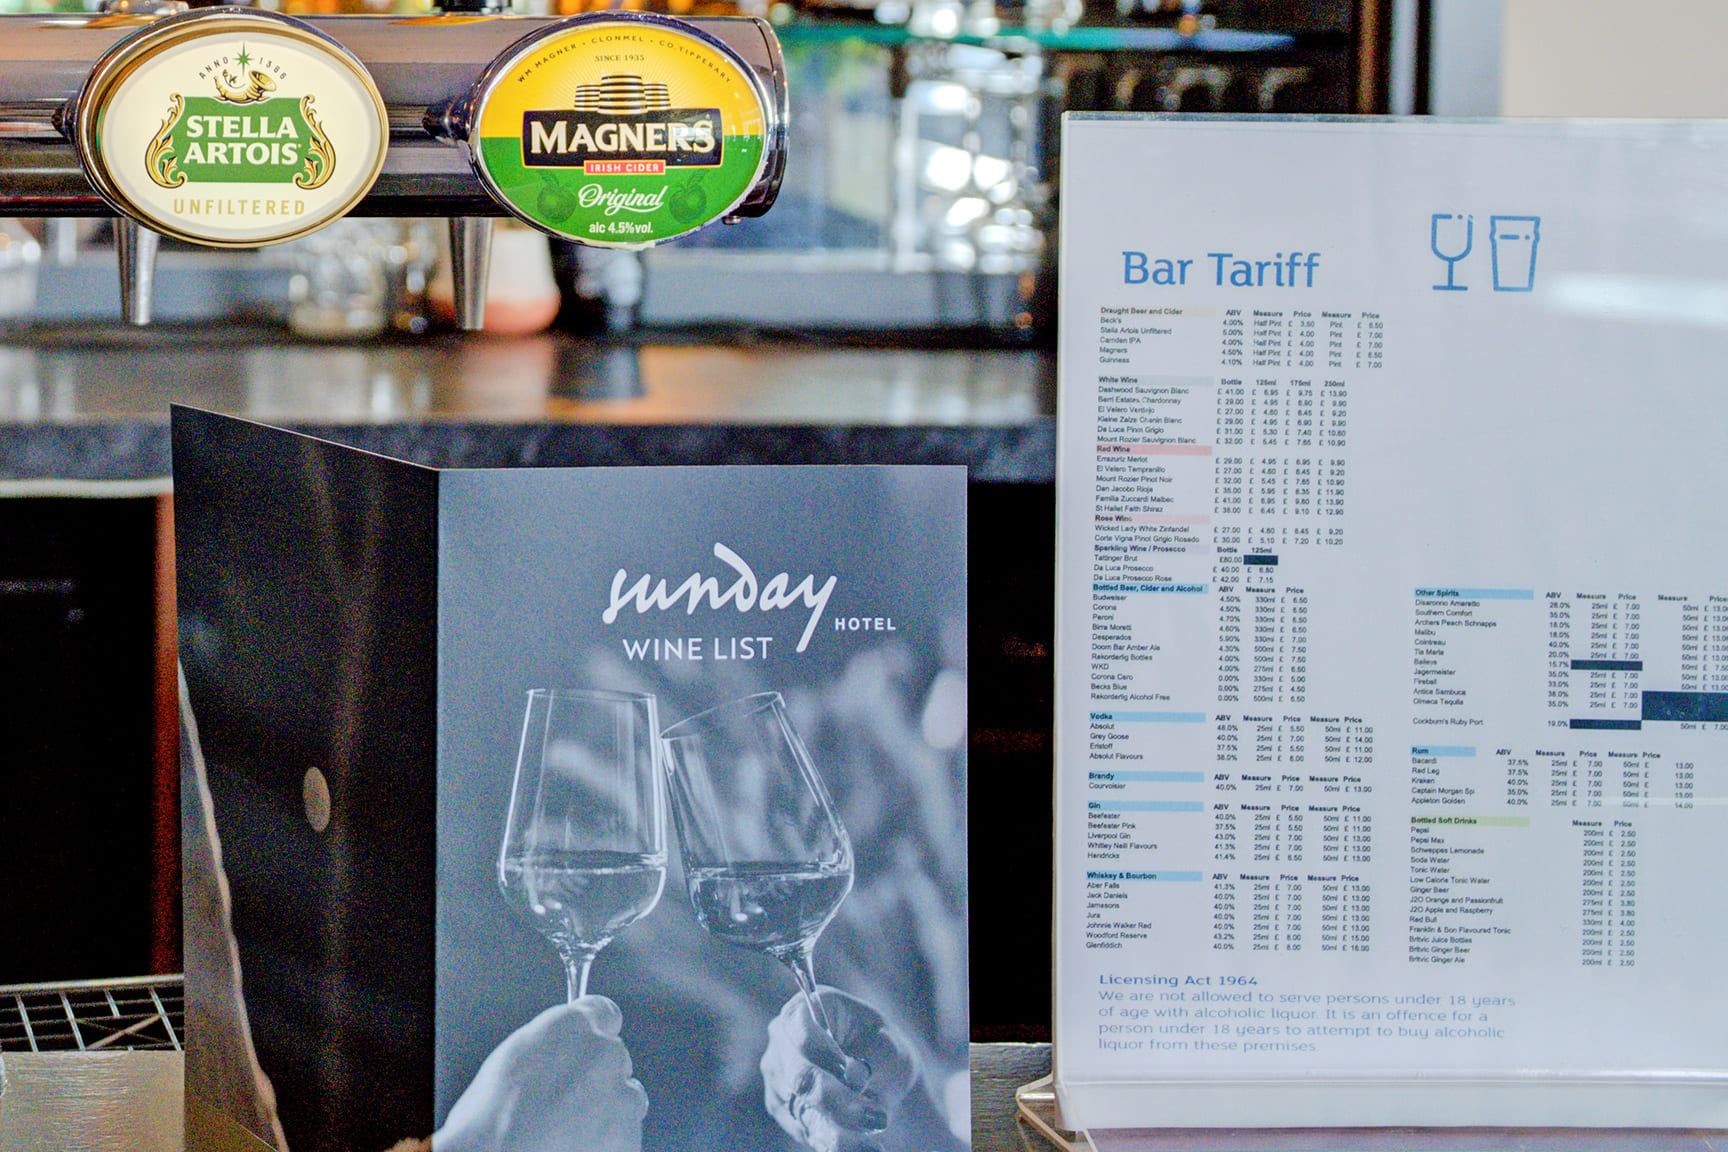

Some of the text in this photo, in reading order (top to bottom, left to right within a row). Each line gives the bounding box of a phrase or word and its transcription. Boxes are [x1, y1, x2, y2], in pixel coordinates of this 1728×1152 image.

[535, 43, 577, 68] MAGNER
[591, 35, 644, 44] CLONMEL
[679, 46, 731, 82] TIPPERARY
[199, 56, 229, 79] ANNO
[186, 115, 299, 139] STELLA
[530, 120, 715, 155] MAGNERS
[183, 143, 299, 165] ARTOIS
[589, 162, 660, 173] IRISH CIDER
[578, 184, 668, 216] Original
[174, 199, 306, 215] UNFILTERED
[589, 223, 606, 234] alc
[1122, 251, 1321, 288] Bar Tariff
[1100, 307, 1183, 316] Draught Beer and Cider
[1100, 316, 1121, 324] Beck's
[1099, 336, 1128, 344] Camden
[1099, 346, 1128, 355] Magners
[1099, 356, 1130, 364] Guinness
[1099, 375, 1138, 384] White Wine
[1221, 378, 1242, 386] Bottle
[1093, 584, 1119, 592] Bottled
[1140, 585, 1160, 593] Cider
[1161, 585, 1174, 593] and
[1175, 585, 1203, 593] Alcohol
[1415, 589, 1435, 597] Other
[602, 542, 896, 653] sunday HOTEL
[1092, 633, 1132, 643] Desperados
[622, 637, 773, 661] WINE LIST
[1090, 712, 1113, 720] Vodka
[1090, 732, 1129, 742] Grey Goose
[1088, 772, 1114, 781] Brandy
[1088, 802, 1101, 810] Gin
[1454, 817, 1477, 825] Drinks
[1086, 872, 1117, 881] Whiskey
[1125, 872, 1157, 880] Bourbon
[1099, 974, 1258, 987] Licensing Act 1964
[1099, 990, 1516, 1008] We are not allowed to serve persons under 18 years
[1099, 1006, 1115, 1017] of
[1120, 1008, 1149, 1019] age
[1154, 1007, 1189, 1017] with
[1194, 1008, 1265, 1019] alcoholic
[1326, 1009, 1337, 1019] It
[1343, 1009, 1355, 1020] is
[1361, 1011, 1380, 1020] an
[1386, 1009, 1447, 1021] offence
[1452, 1011, 1473, 1021] for
[1479, 1012, 1488, 1021] a
[1099, 1023, 1505, 1039] person under 18 years to attempt to buy alcoholic
[1099, 1038, 1143, 1051] liquor
[1150, 1039, 1189, 1050] from
[1194, 1040, 1238, 1050] these
